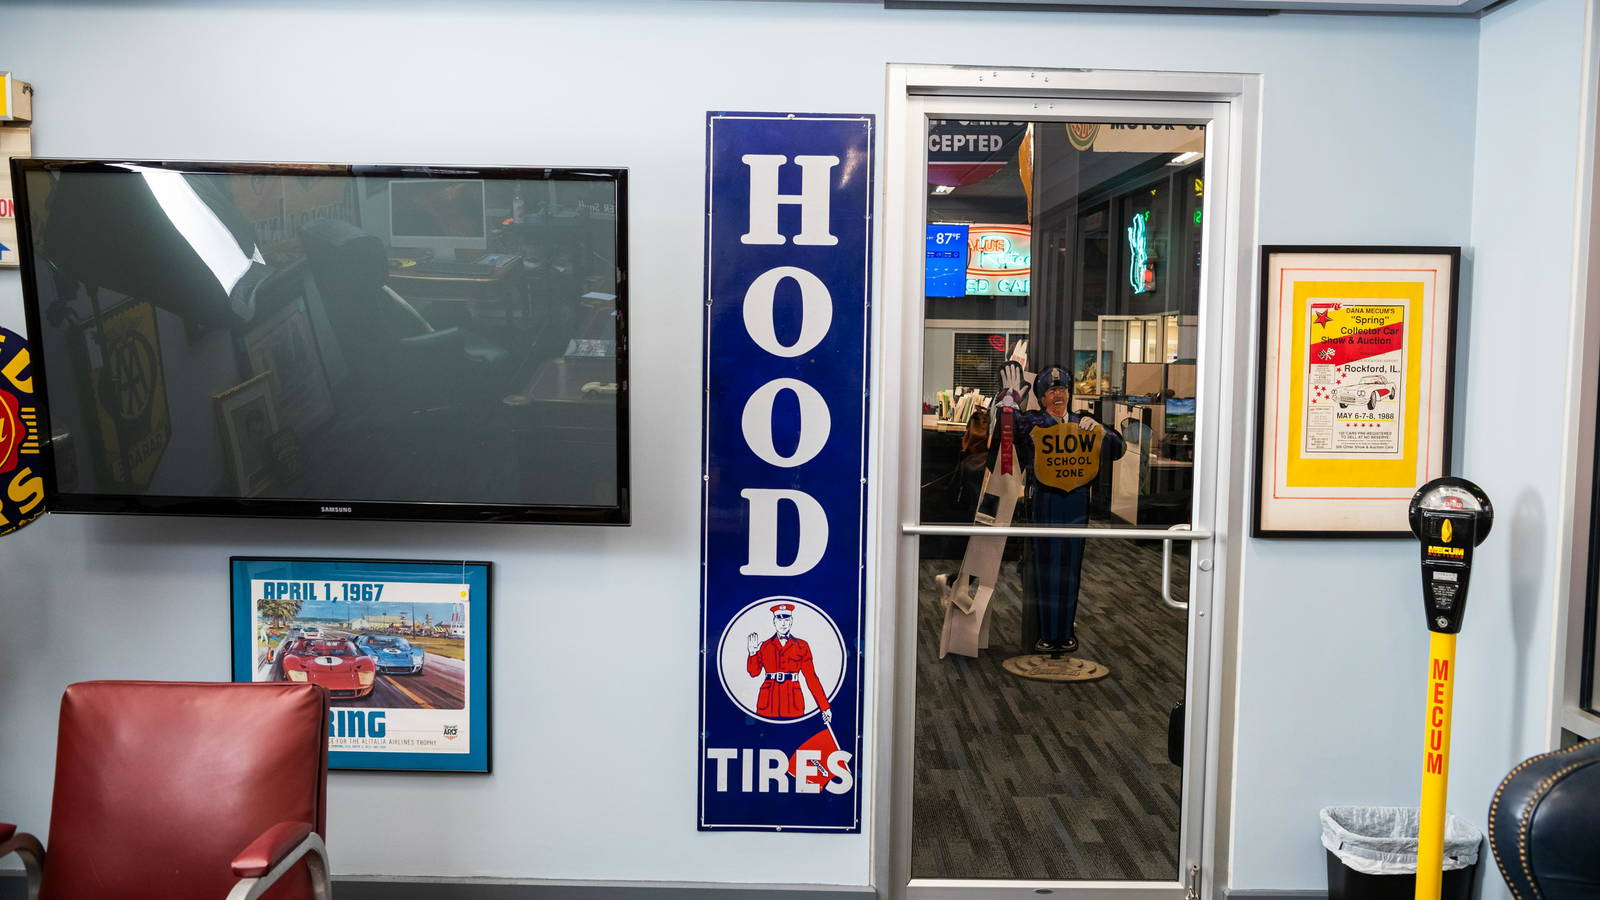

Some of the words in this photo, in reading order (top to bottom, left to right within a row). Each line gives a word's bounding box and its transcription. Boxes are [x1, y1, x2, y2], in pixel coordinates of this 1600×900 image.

[928, 134, 1003, 152] CEPTED
[1351, 316, 1390, 326] "Spring"
[1340, 326, 1380, 334] Collector
[1383, 327, 1399, 335] Car
[1321, 336, 1346, 344] Show
[1348, 336, 1354, 344] &
[739, 154, 840, 576] HOOD
[1344, 364, 1388, 374] Rockford,
[1041, 434, 1096, 454] SLOW
[1046, 456, 1092, 466] SCHOOL
[1056, 468, 1084, 478] ZONE
[1428, 546, 1464, 556] MECUM
[263, 582, 317, 600] APRIL
[342, 583, 384, 602] 1967
[1426, 658, 1449, 775] MECUM
[707, 748, 854, 795] TIRES
